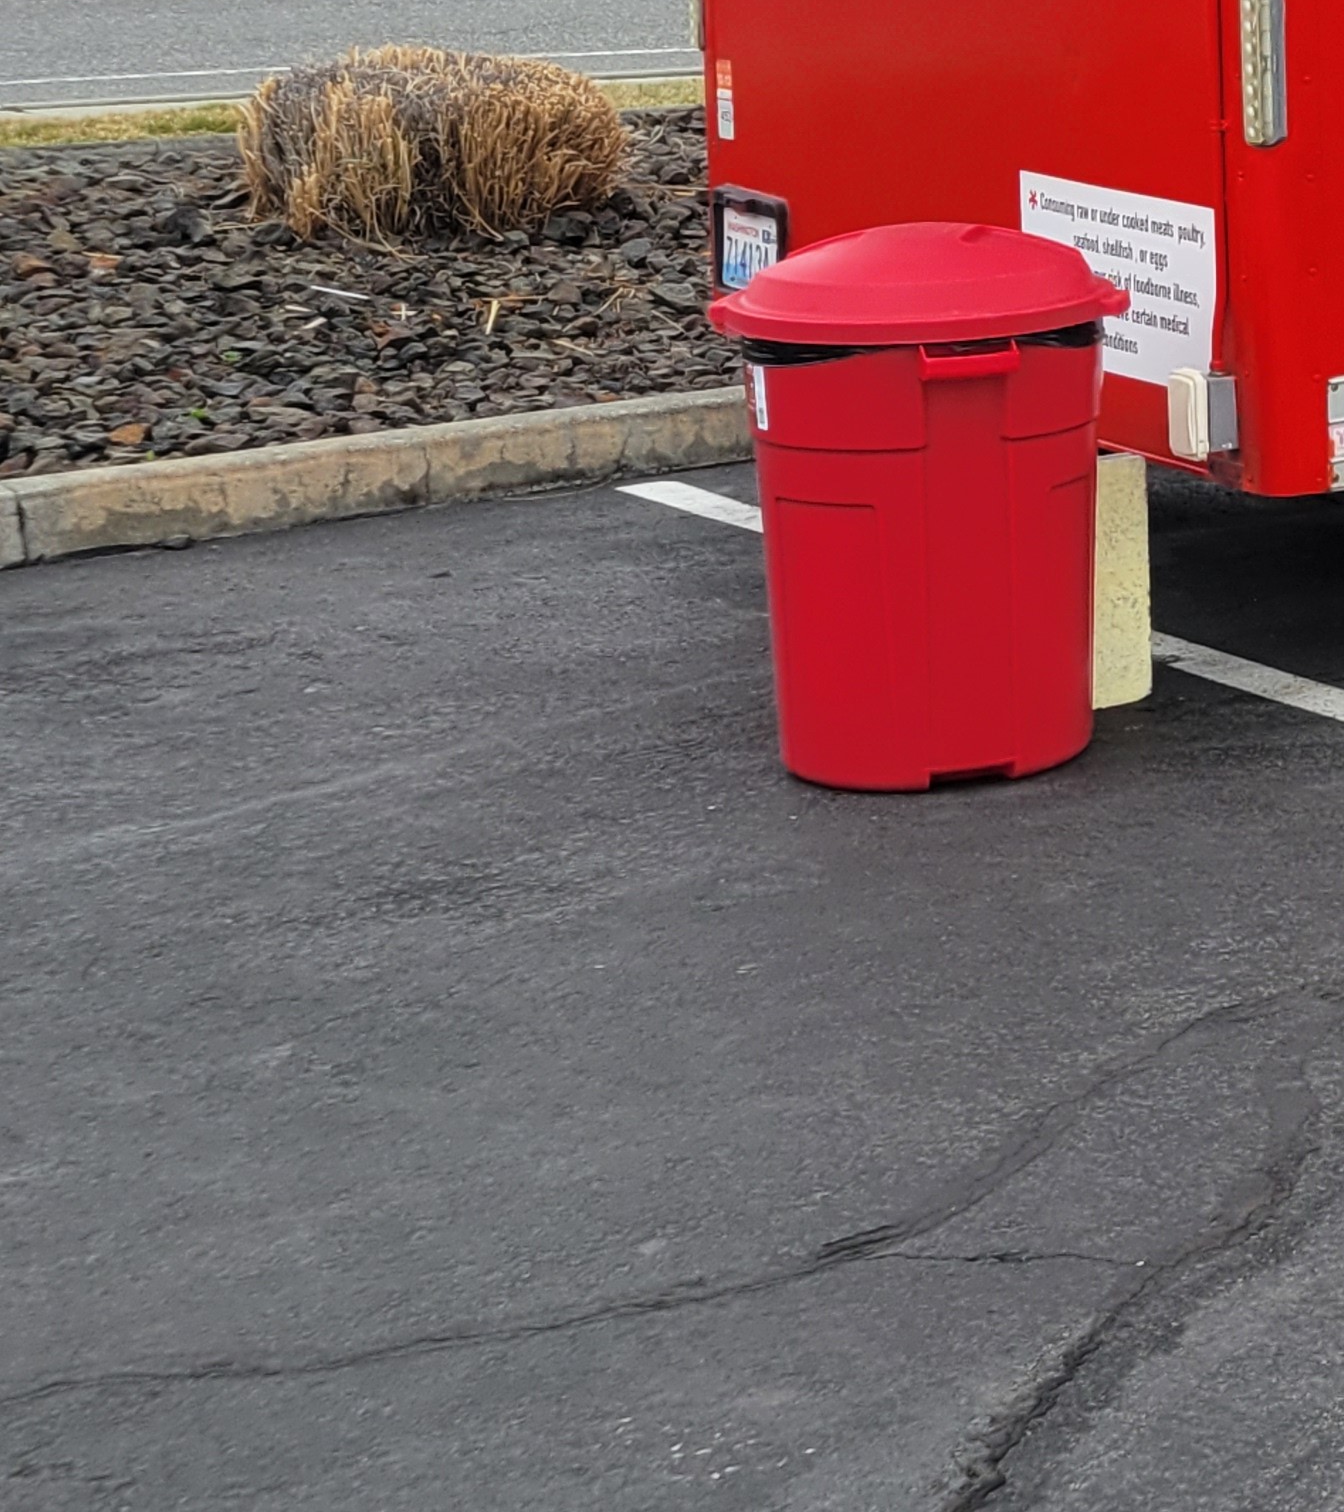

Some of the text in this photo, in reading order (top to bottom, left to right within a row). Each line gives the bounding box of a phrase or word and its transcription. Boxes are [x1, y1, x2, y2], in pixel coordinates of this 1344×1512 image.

[1040, 192, 1075, 222] Consuming
[1077, 203, 1089, 220] raw
[1091, 208, 1098, 222] or
[1100, 206, 1120, 227] under
[1122, 211, 1149, 233] cooked
[1151, 218, 1174, 238] meats
[1139, 248, 1148, 263] or
[1149, 250, 1168, 272] eggs
[1124, 272, 1132, 291] of
[1133, 273, 1172, 301] foodborne
[1132, 308, 1159, 328] certain
[1160, 314, 1190, 336] medical
[1102, 331, 1139, 355] onditions
